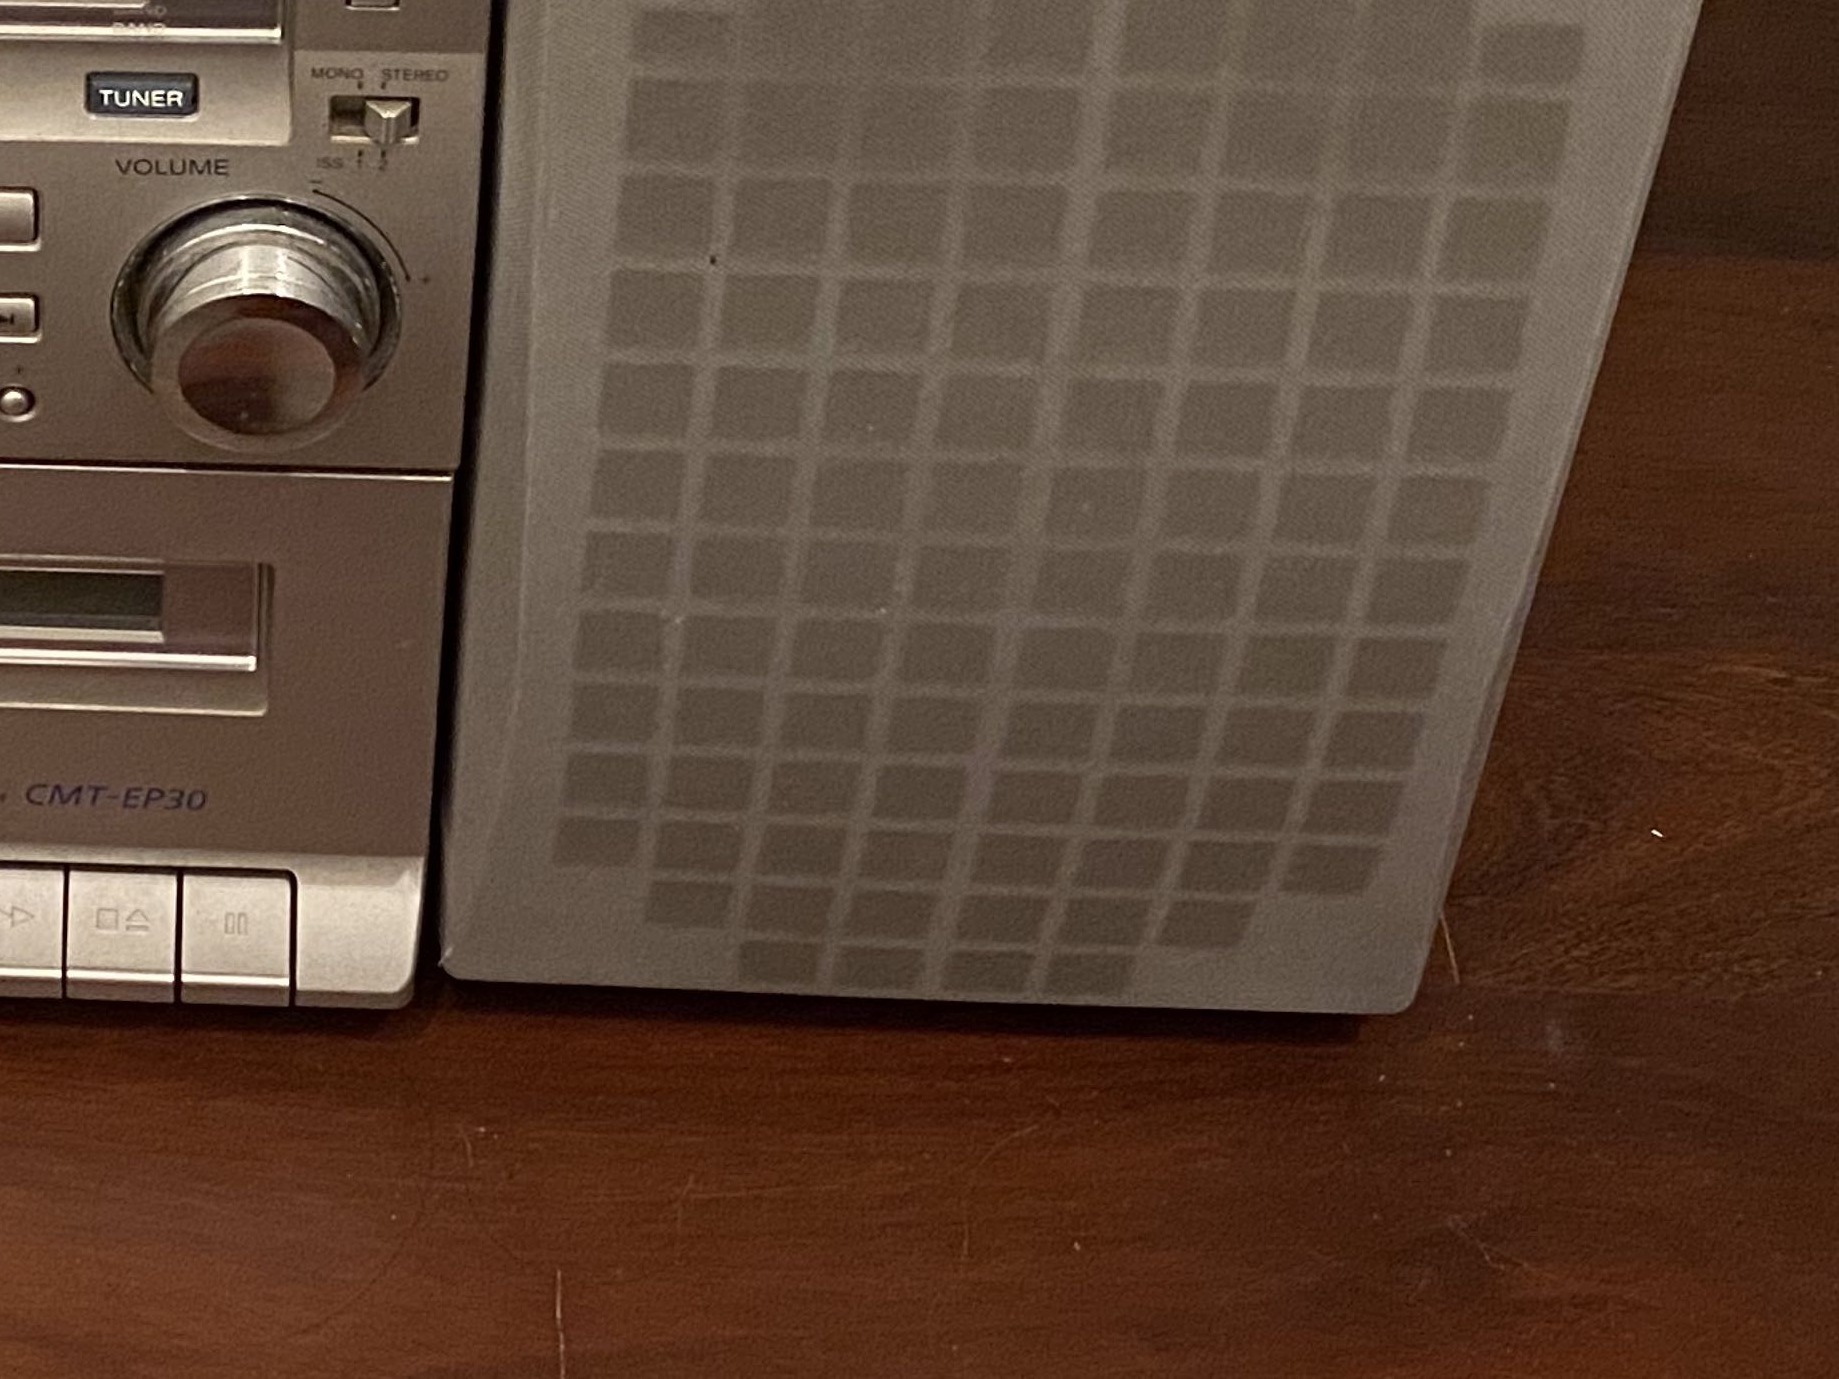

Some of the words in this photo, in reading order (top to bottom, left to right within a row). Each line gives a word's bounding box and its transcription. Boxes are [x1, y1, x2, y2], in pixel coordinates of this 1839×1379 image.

[311, 67, 364, 81] MONO
[380, 68, 450, 83] STEREO
[98, 88, 185, 108] TUNER
[115, 157, 230, 177] VOLUME
[25, 783, 209, 812] CMT-EP30
